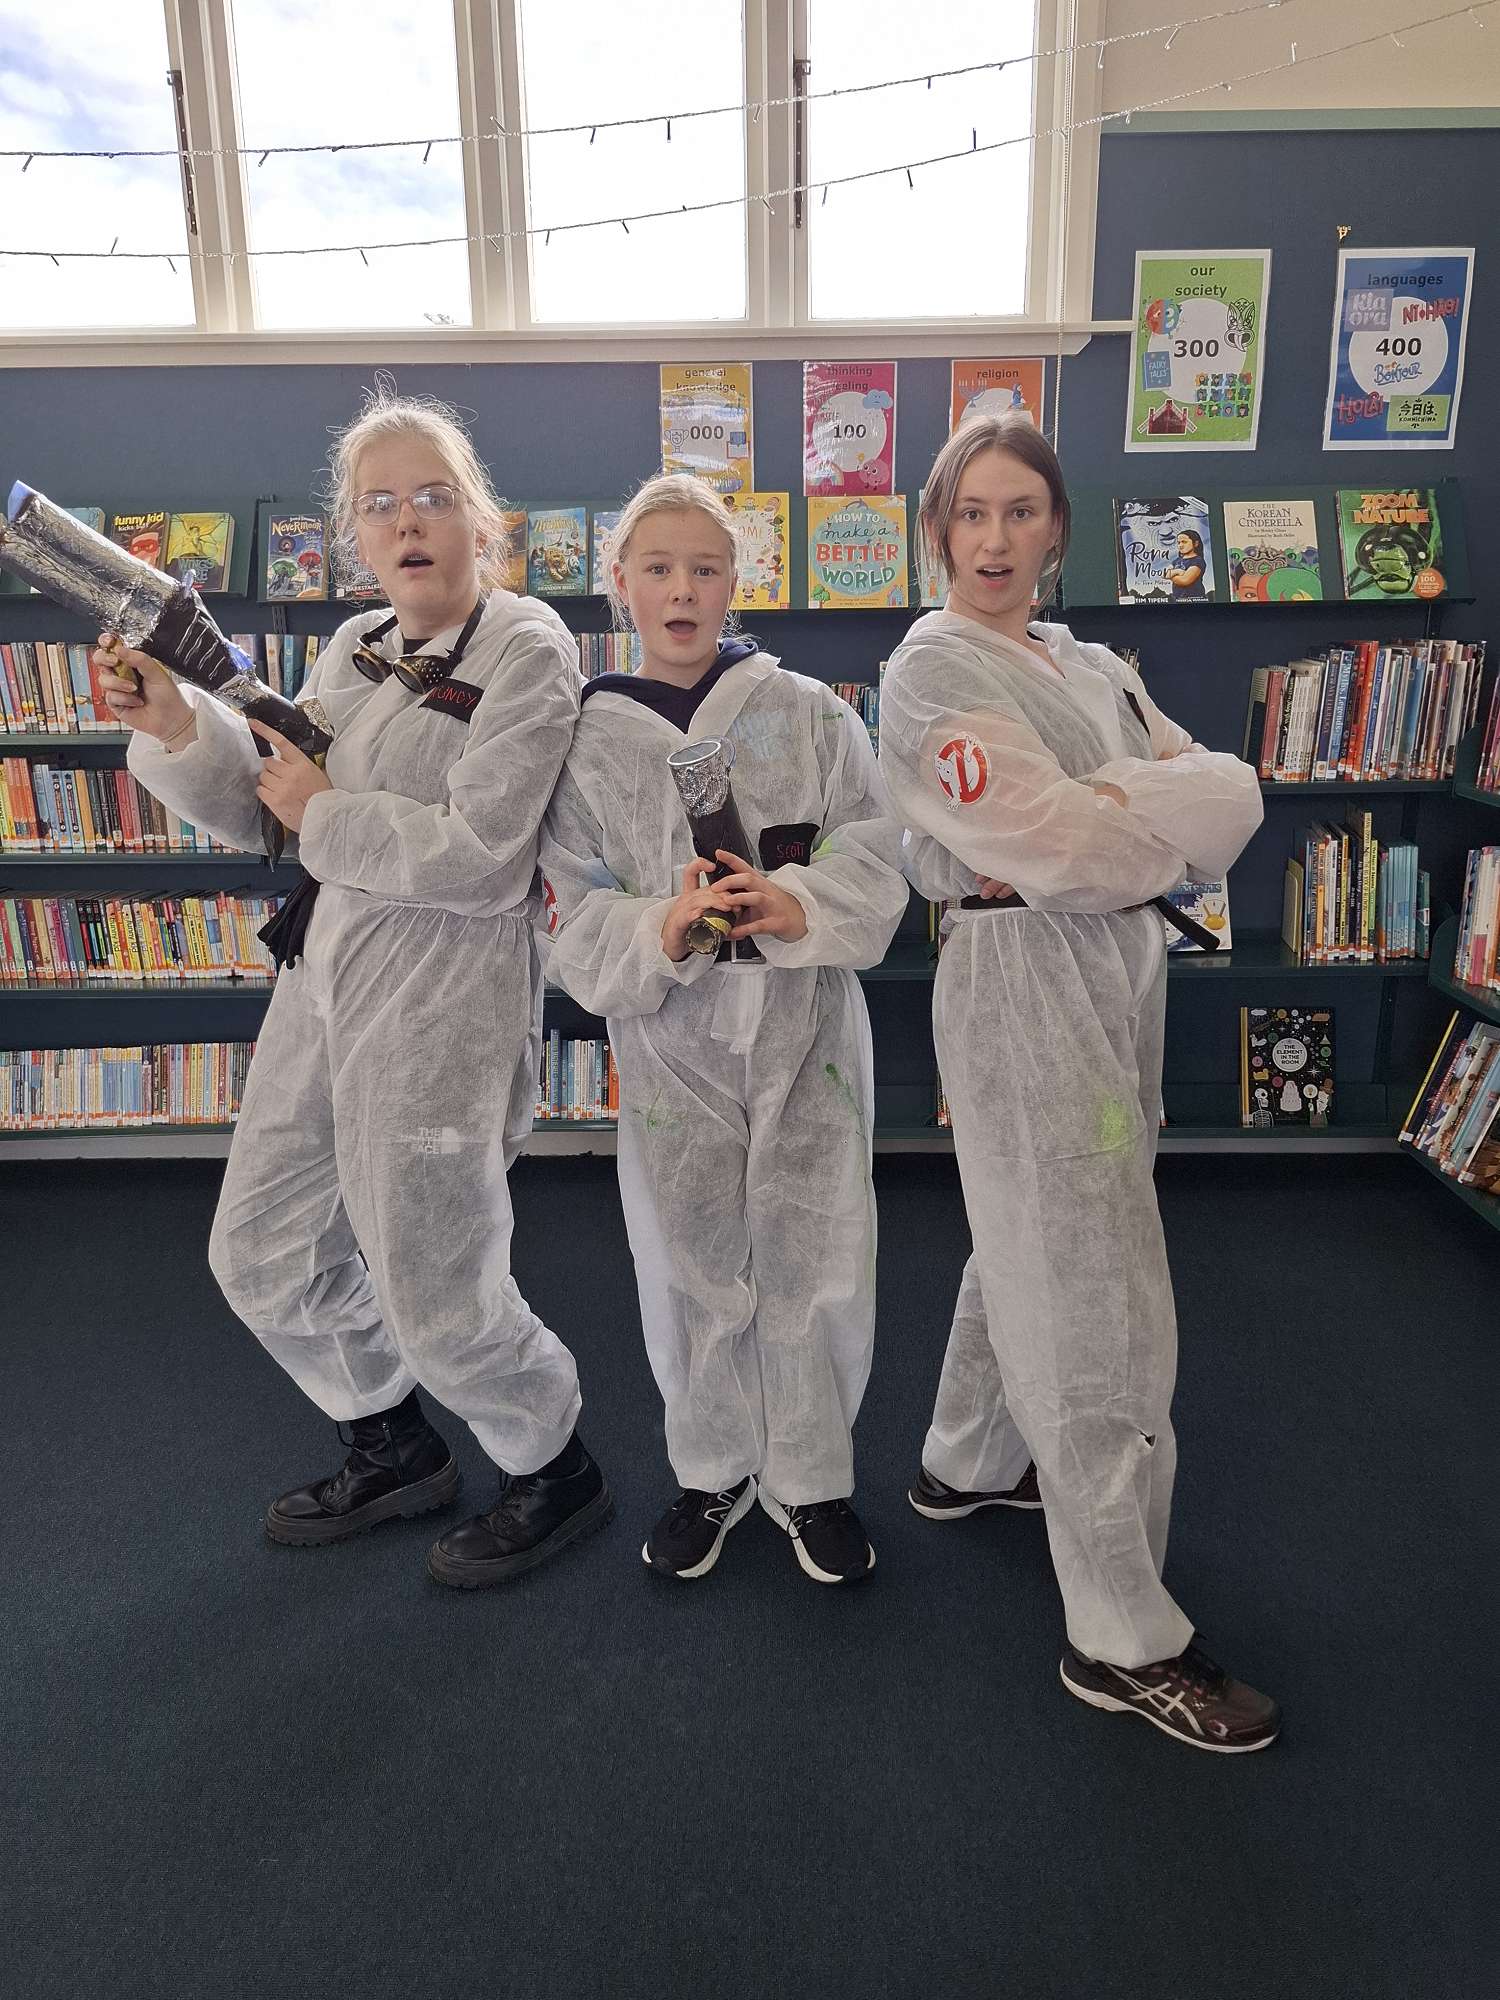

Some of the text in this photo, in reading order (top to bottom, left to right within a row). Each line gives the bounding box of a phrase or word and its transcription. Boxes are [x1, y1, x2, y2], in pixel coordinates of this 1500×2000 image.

[1190, 265, 1215, 276] our
[1367, 274, 1444, 287] languages
[1175, 284, 1227, 298] society
[1173, 340, 1219, 357] 300
[1375, 338, 1422, 356] 400
[827, 366, 872, 376] thinking
[977, 369, 1019, 380] religion
[676, 382, 736, 393] knowledge
[690, 425, 724, 440] 000
[833, 424, 867, 438] 100
[1360, 493, 1418, 508] ZOOM
[115, 512, 164, 526] funny kid
[834, 512, 880, 523] HOW TO
[1247, 508, 1291, 518] KOREAN
[1353, 509, 1430, 523] NATURE
[1238, 517, 1303, 527] CINDERELLA
[824, 524, 890, 540] make a
[815, 543, 899, 562] BETTER
[1126, 541, 1170, 562] Rona
[180, 558, 215, 570] WINGS
[1135, 562, 1171, 579] Moon
[822, 566, 896, 588] WORLD
